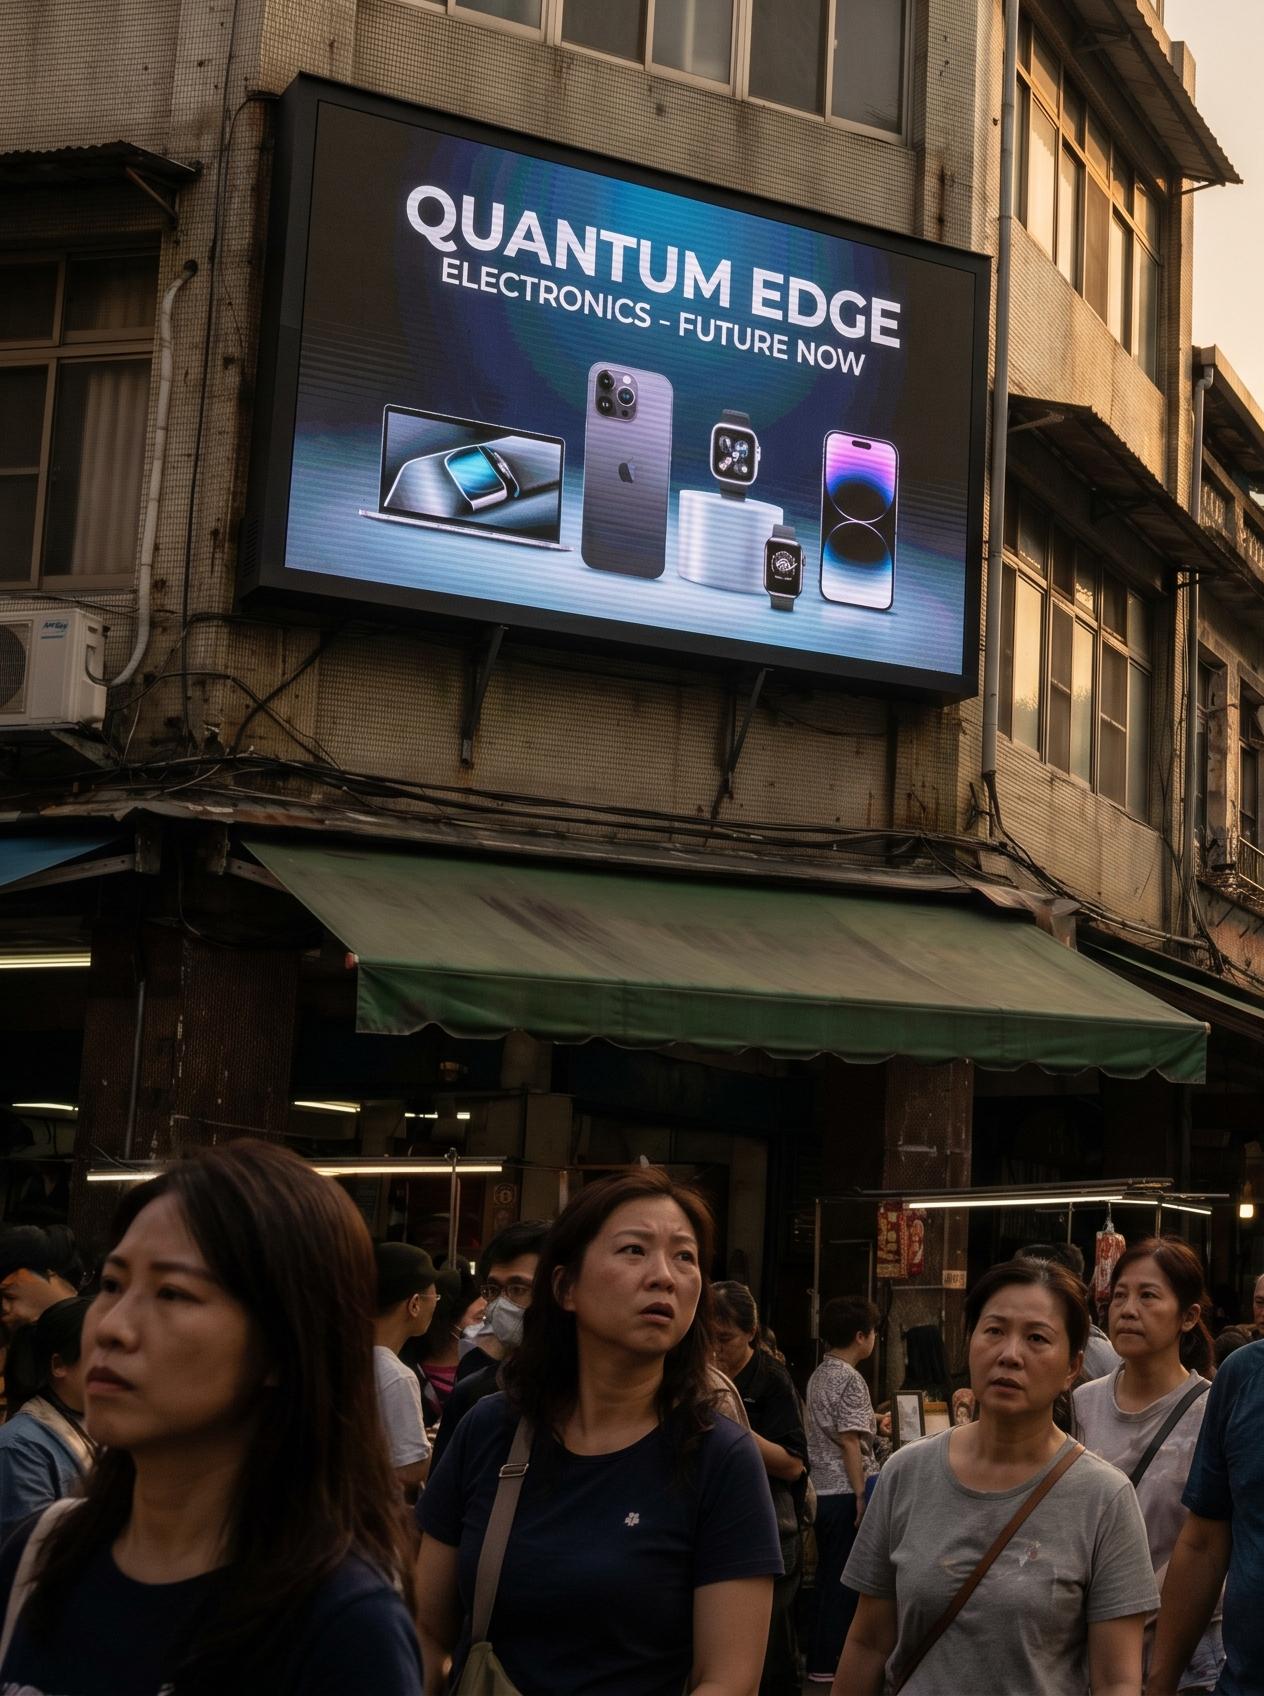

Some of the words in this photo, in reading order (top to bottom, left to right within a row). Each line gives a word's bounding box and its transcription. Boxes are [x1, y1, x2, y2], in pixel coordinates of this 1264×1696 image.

[406, 184, 732, 309] QUANTUM
[751, 266, 901, 349] EDGE
[441, 256, 652, 329] ELECTRONICS
[678, 312, 788, 361] FUTURE
[797, 339, 866, 376] NOW
